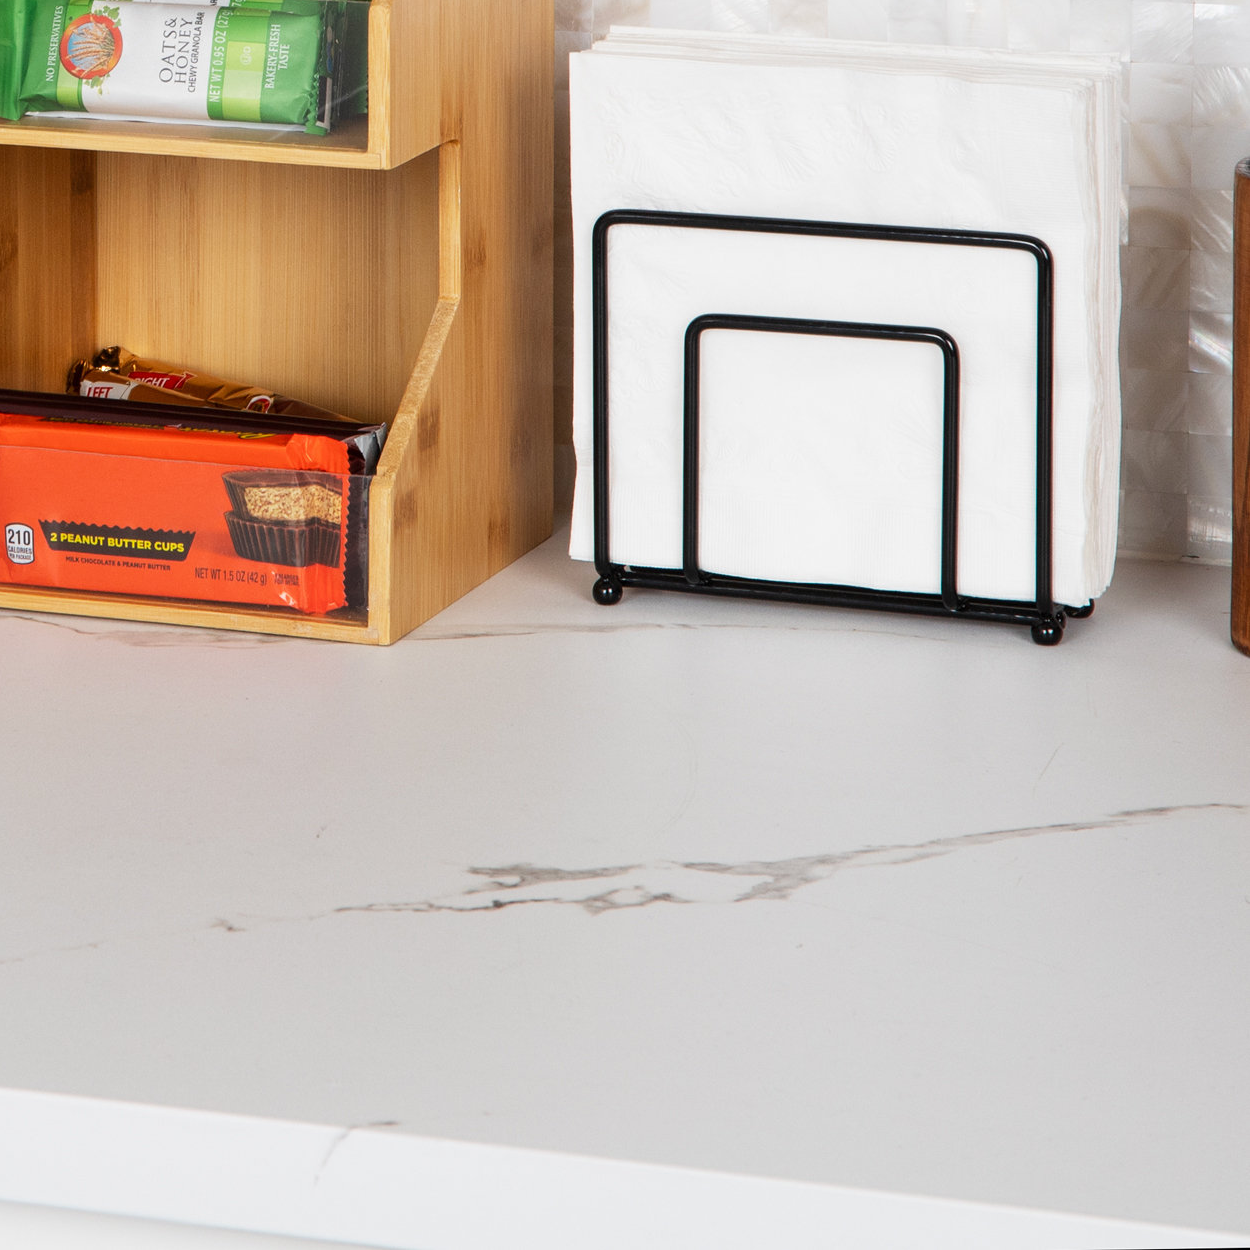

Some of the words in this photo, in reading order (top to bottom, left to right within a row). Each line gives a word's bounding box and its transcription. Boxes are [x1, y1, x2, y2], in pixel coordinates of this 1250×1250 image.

[195, 12, 205, 25] BAR
[49, 5, 63, 68] PRESERVATIVES
[191, 25, 202, 64] GRANOLA
[215, 30, 226, 44] OZ
[174, 18, 193, 83] HONEY
[213, 46, 225, 66] 0.95
[265, 24, 281, 89] BAKERY-FRESH
[278, 43, 290, 70] TASTE
[46, 68, 55, 82] NO
[188, 64, 197, 93] CHEWY
[211, 68, 222, 83] WT
[210, 89, 220, 102] NET
[87, 386, 113, 399] LEFT
[7, 528, 31, 546] 210
[50, 533, 57, 542] 2
[60, 533, 105, 546] PEANUT
[107, 537, 151, 550] BUTTER
[154, 541, 184, 553] CUPS
[8, 545, 32, 555] CALORIES
[81, 557, 116, 566] CHOCOLATE
[123, 561, 146, 569] PEANUT
[148, 563, 171, 571] BUTTER
[194, 567, 208, 579] NET
[210, 569, 221, 580] WT
[223, 570, 234, 581] 1.5
[236, 570, 246, 582] OZ
[247, 571, 259, 583] (42
[260, 573, 268, 585] g)
